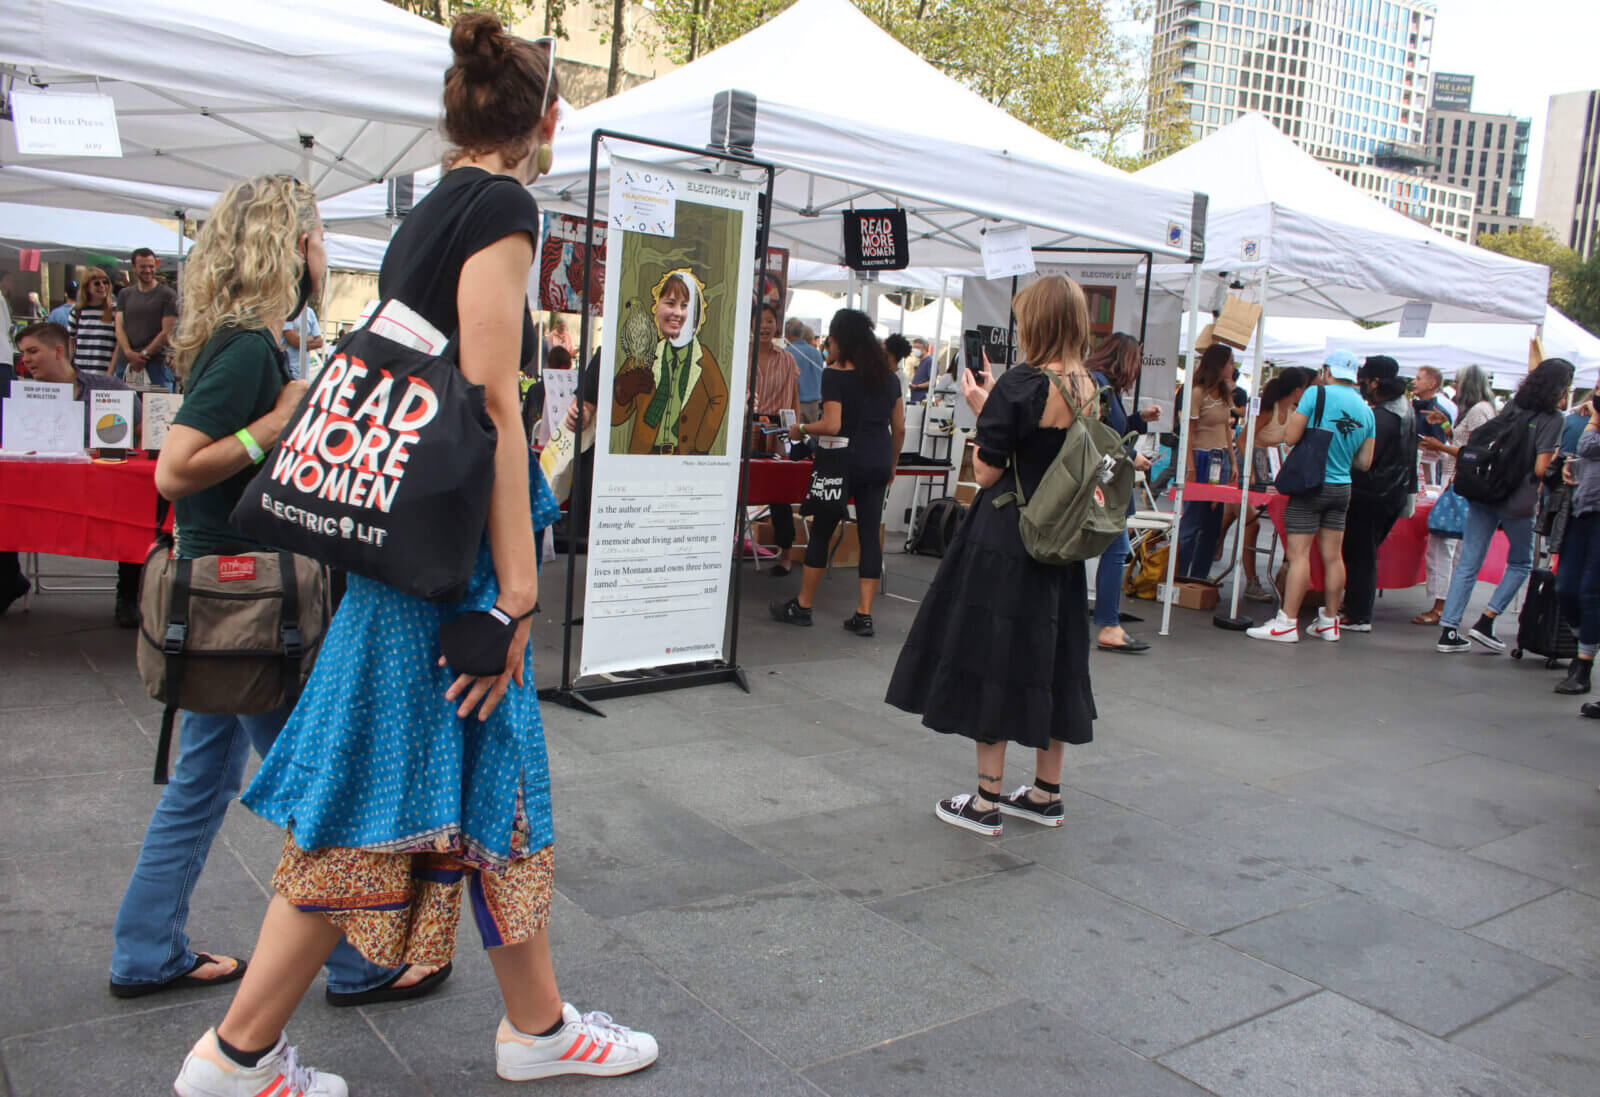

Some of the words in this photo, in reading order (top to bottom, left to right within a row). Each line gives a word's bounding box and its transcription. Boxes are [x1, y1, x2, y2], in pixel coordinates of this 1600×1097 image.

[29, 115, 50, 125] Red
[53, 116, 75, 126] Hen
[76, 117, 105, 127] Press
[687, 182, 730, 198] ELECTRIC
[860, 217, 892, 234] READ
[862, 233, 895, 247] MORE
[862, 246, 895, 256] WOMEN
[1081, 271, 1114, 279] ELECTRIC
[1141, 354, 1166, 367] oices
[309, 353, 439, 431] READ
[286, 406, 421, 479] MORE
[271, 447, 400, 513] WOMEN
[605, 504, 617, 513] the
[618, 504, 641, 513] author
[643, 504, 652, 513] of
[261, 492, 338, 536] ELECTRIC
[356, 522, 388, 547] LIT
[597, 521, 623, 530] Among
[624, 520, 636, 528] the
[601, 537, 629, 546] memoir
[631, 536, 651, 545] about
[652, 535, 672, 546] living
[672, 535, 685, 544] and
[686, 535, 709, 545] writing
[594, 567, 612, 576] lives
[613, 567, 621, 575] in
[622, 566, 652, 575] Montana
[653, 565, 666, 573] and
[685, 563, 701, 571] three
[702, 562, 722, 570] horses
[593, 580, 618, 588] named
[704, 585, 718, 594] and
